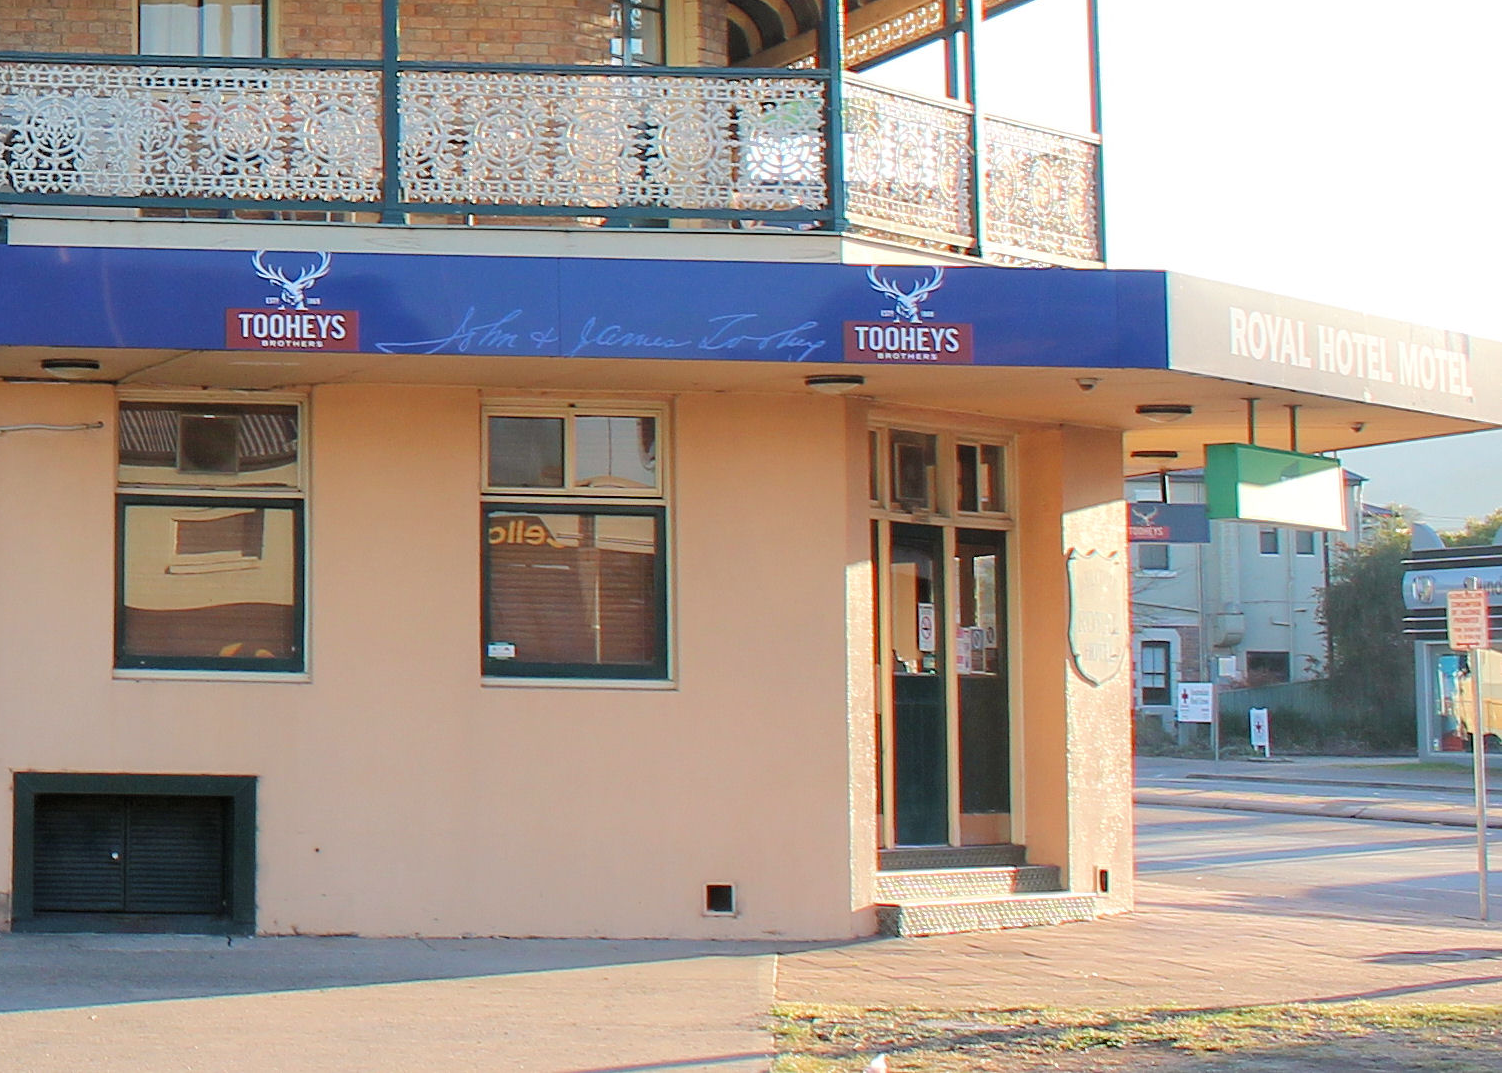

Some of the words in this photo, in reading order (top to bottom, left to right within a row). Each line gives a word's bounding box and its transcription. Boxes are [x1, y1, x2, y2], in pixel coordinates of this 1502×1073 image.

[238, 313, 347, 340] TOOHEYS
[570, 316, 692, 357] James
[854, 326, 960, 352] TOOHEYS
[261, 339, 324, 348] BROTHERS
[877, 352, 937, 361] BROTHERS
[1229, 306, 1312, 369] ROYAL
[1317, 324, 1394, 383] HOTEL
[1397, 341, 1474, 397] MOTEL
